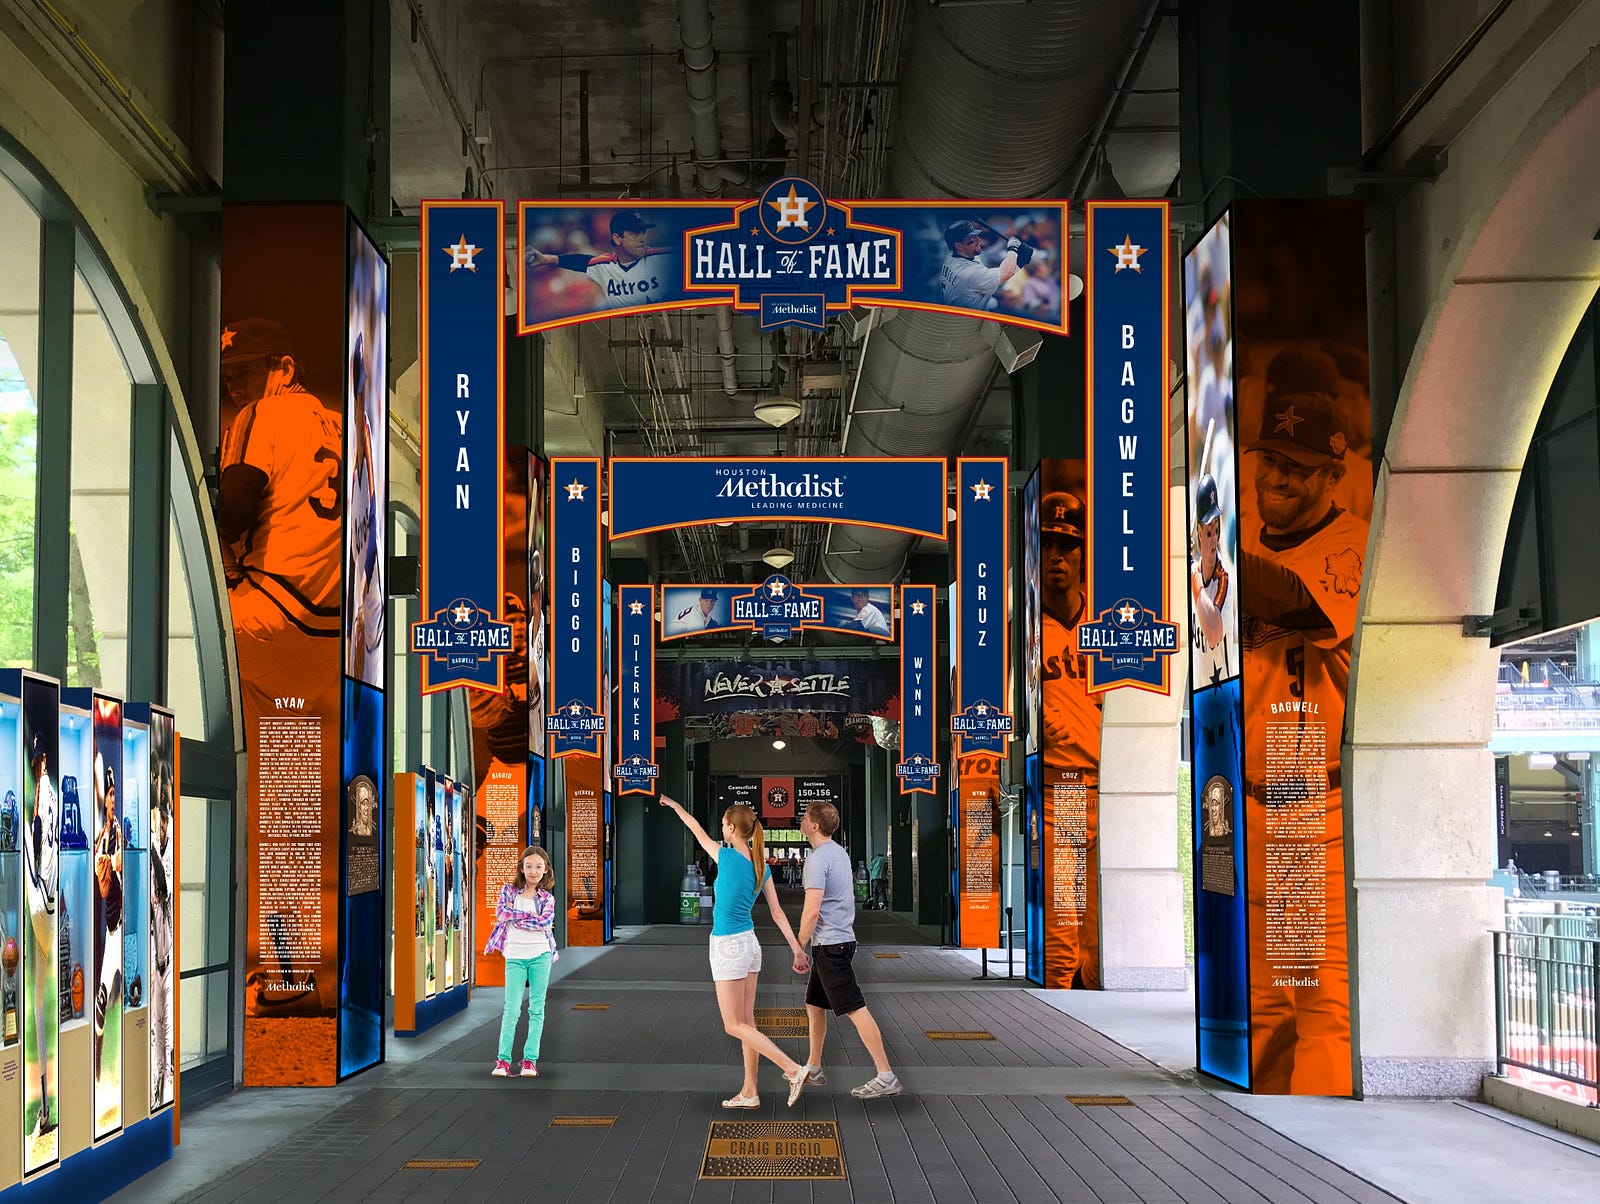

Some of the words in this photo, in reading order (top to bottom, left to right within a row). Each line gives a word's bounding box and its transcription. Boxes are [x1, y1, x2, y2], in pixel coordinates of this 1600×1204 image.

[695, 238, 772, 279] HALL
[780, 249, 799, 274] of
[808, 238, 891, 279] FAME
[607, 275, 660, 297] Astros
[771, 304, 818, 314] Methodist
[455, 373, 470, 510] RYAN
[1118, 324, 1138, 572] BAGWELL
[715, 468, 767, 476] HOUSTON
[715, 473, 844, 498] Methodist
[571, 547, 581, 653] BIGGO
[735, 600, 769, 618] HALL
[783, 600, 819, 618] FAME
[977, 562, 987, 647] CRUZ
[416, 626, 453, 647] HALL
[469, 626, 510, 647] FAME
[1081, 626, 1118, 647] HALL
[1134, 626, 1175, 647] FAME
[632, 633, 640, 741] DIERKER
[703, 671, 767, 698] NEVER
[787, 673, 851, 694] SETTLE
[913, 656, 923, 717] WYNN
[274, 696, 305, 710] RYAN
[1270, 701, 1319, 715] BAGWELL
[547, 717, 570, 730] HALL
[580, 717, 605, 730] FAME
[953, 717, 977, 730] HALL
[986, 717, 1011, 730] FAME
[616, 766, 633, 776] HALL
[639, 766, 657, 776] FAME
[898, 765, 915, 775] HALL
[920, 765, 939, 775] FAME
[797, 788, 831, 797] 150-156
[265, 981, 316, 992] Methodist
[1272, 977, 1320, 988] Methodist
[729, 1140, 770, 1155] CRAIG
[775, 1141, 822, 1156] BIGGIO
